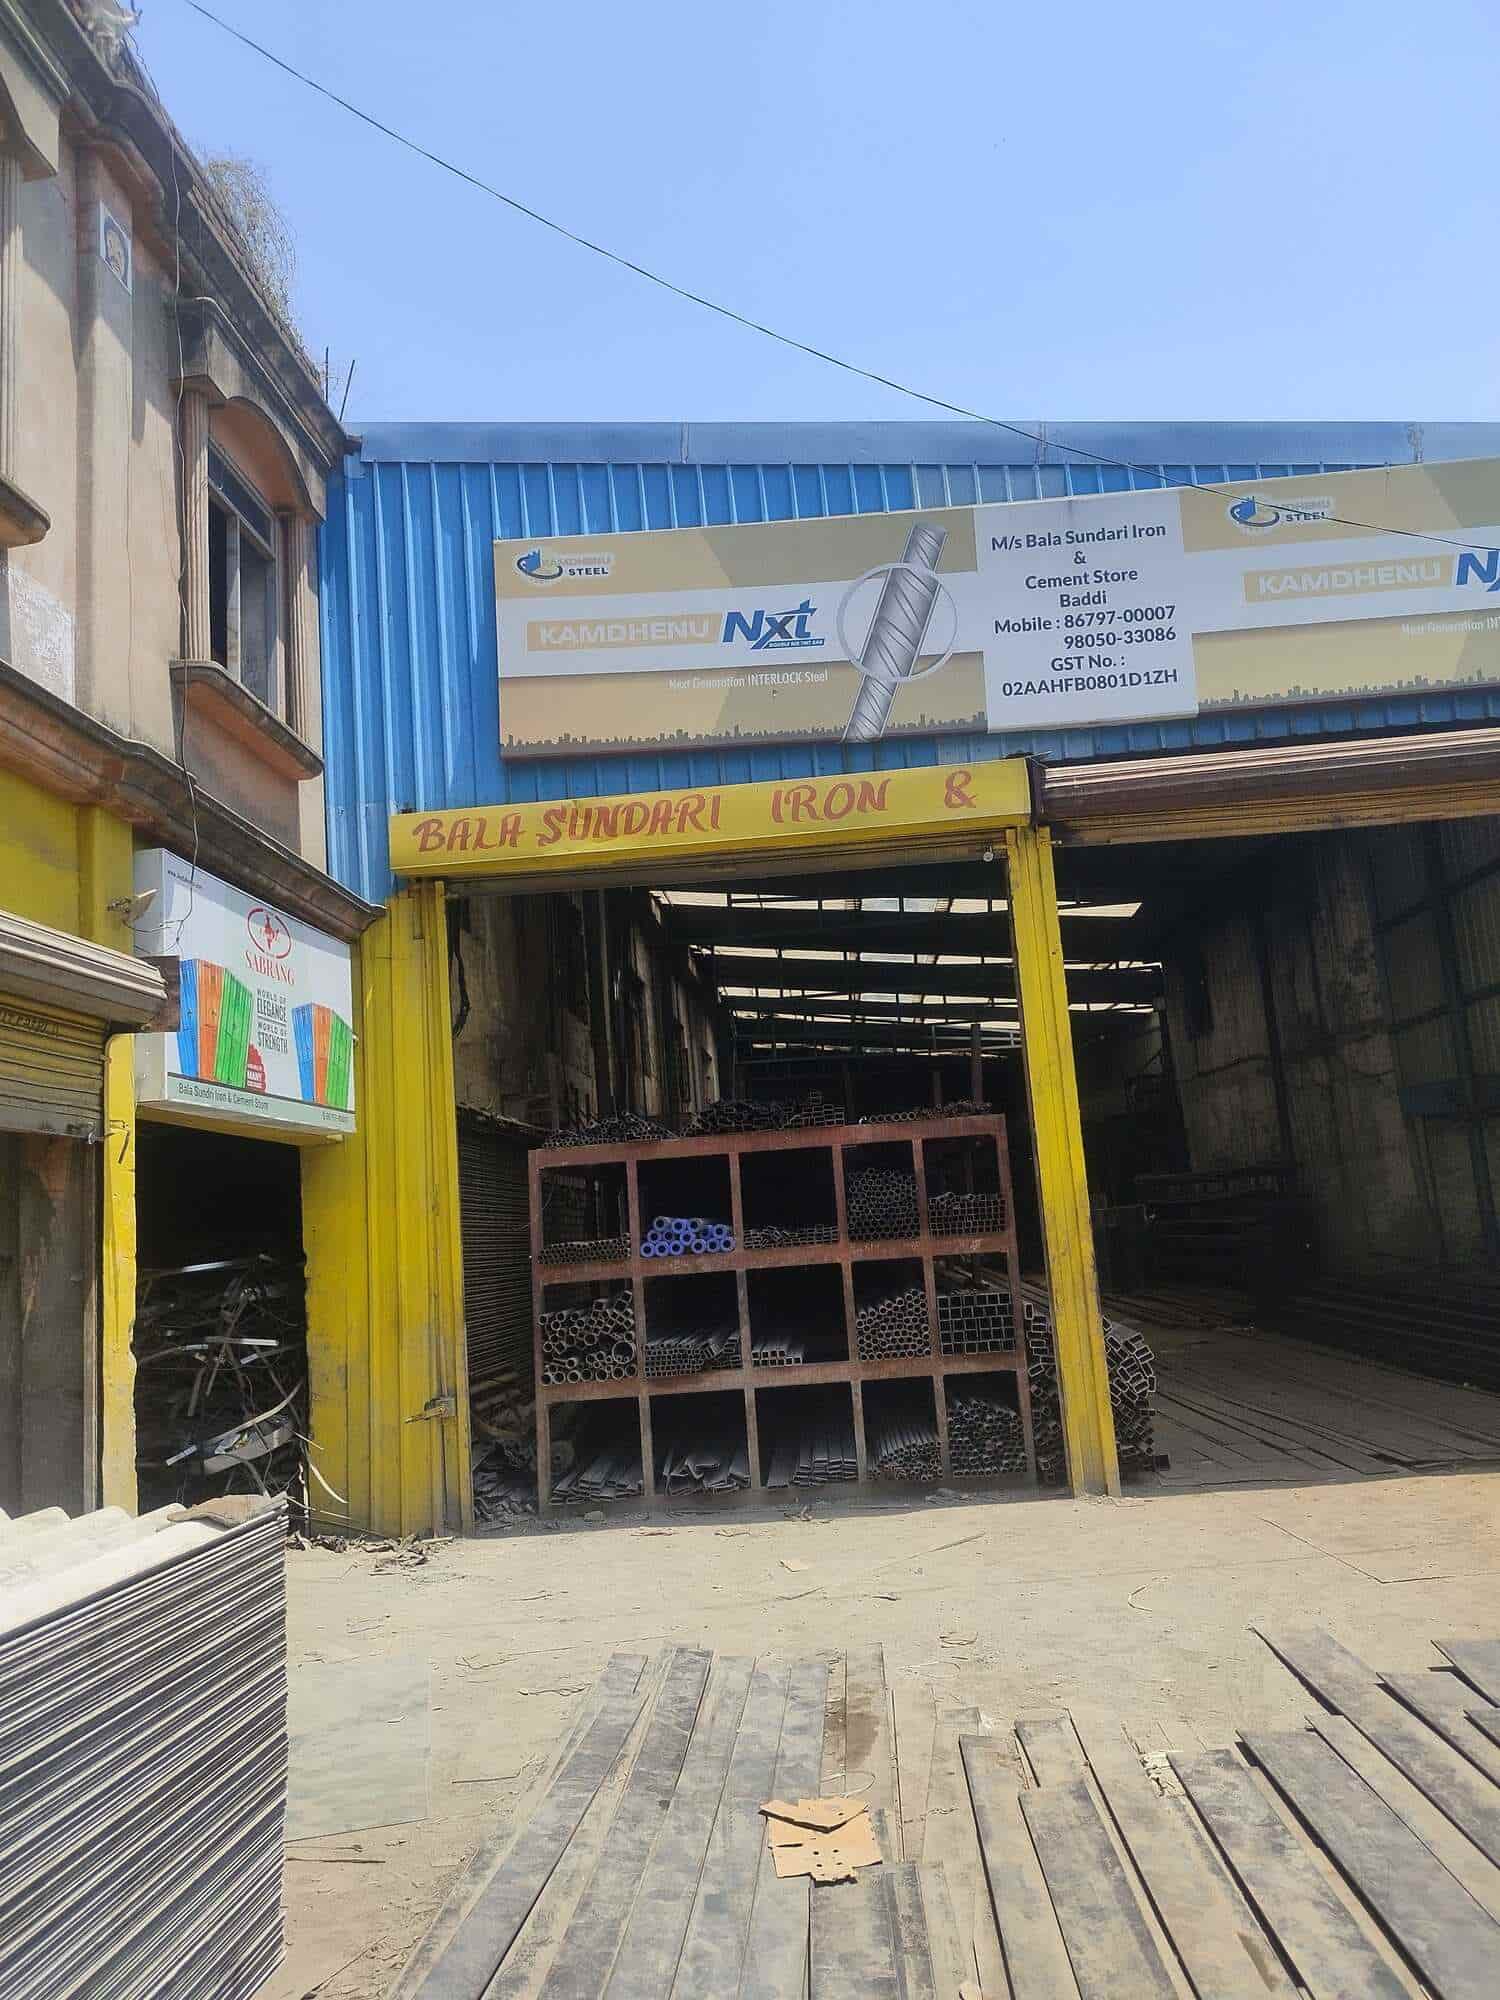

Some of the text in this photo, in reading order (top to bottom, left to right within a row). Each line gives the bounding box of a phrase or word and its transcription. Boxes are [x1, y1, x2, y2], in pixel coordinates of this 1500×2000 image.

[991, 524, 1167, 550] M/s Bala Sundari Iron
[1073, 550, 1088, 564] &
[568, 566, 609, 577] STEEL
[1025, 569, 1139, 590] Cement Store
[1258, 559, 1441, 594] KAMDHENU
[1059, 590, 1107, 608] Baddi
[539, 599, 818, 651] KAMDHENU Nxt
[994, 616, 1053, 634] Mobile
[1064, 605, 1176, 628] 86797-00007
[1063, 626, 1177, 649] 98050-33086
[1051, 655, 1085, 671] GST
[1088, 653, 1117, 669] No.
[748, 672, 802, 686] INTERLOCK
[805, 669, 828, 682] Steel
[1002, 669, 1177, 696] 02AAHFB0801D1ZH
[412, 769, 977, 853] BALA SUNDARI IRON &
